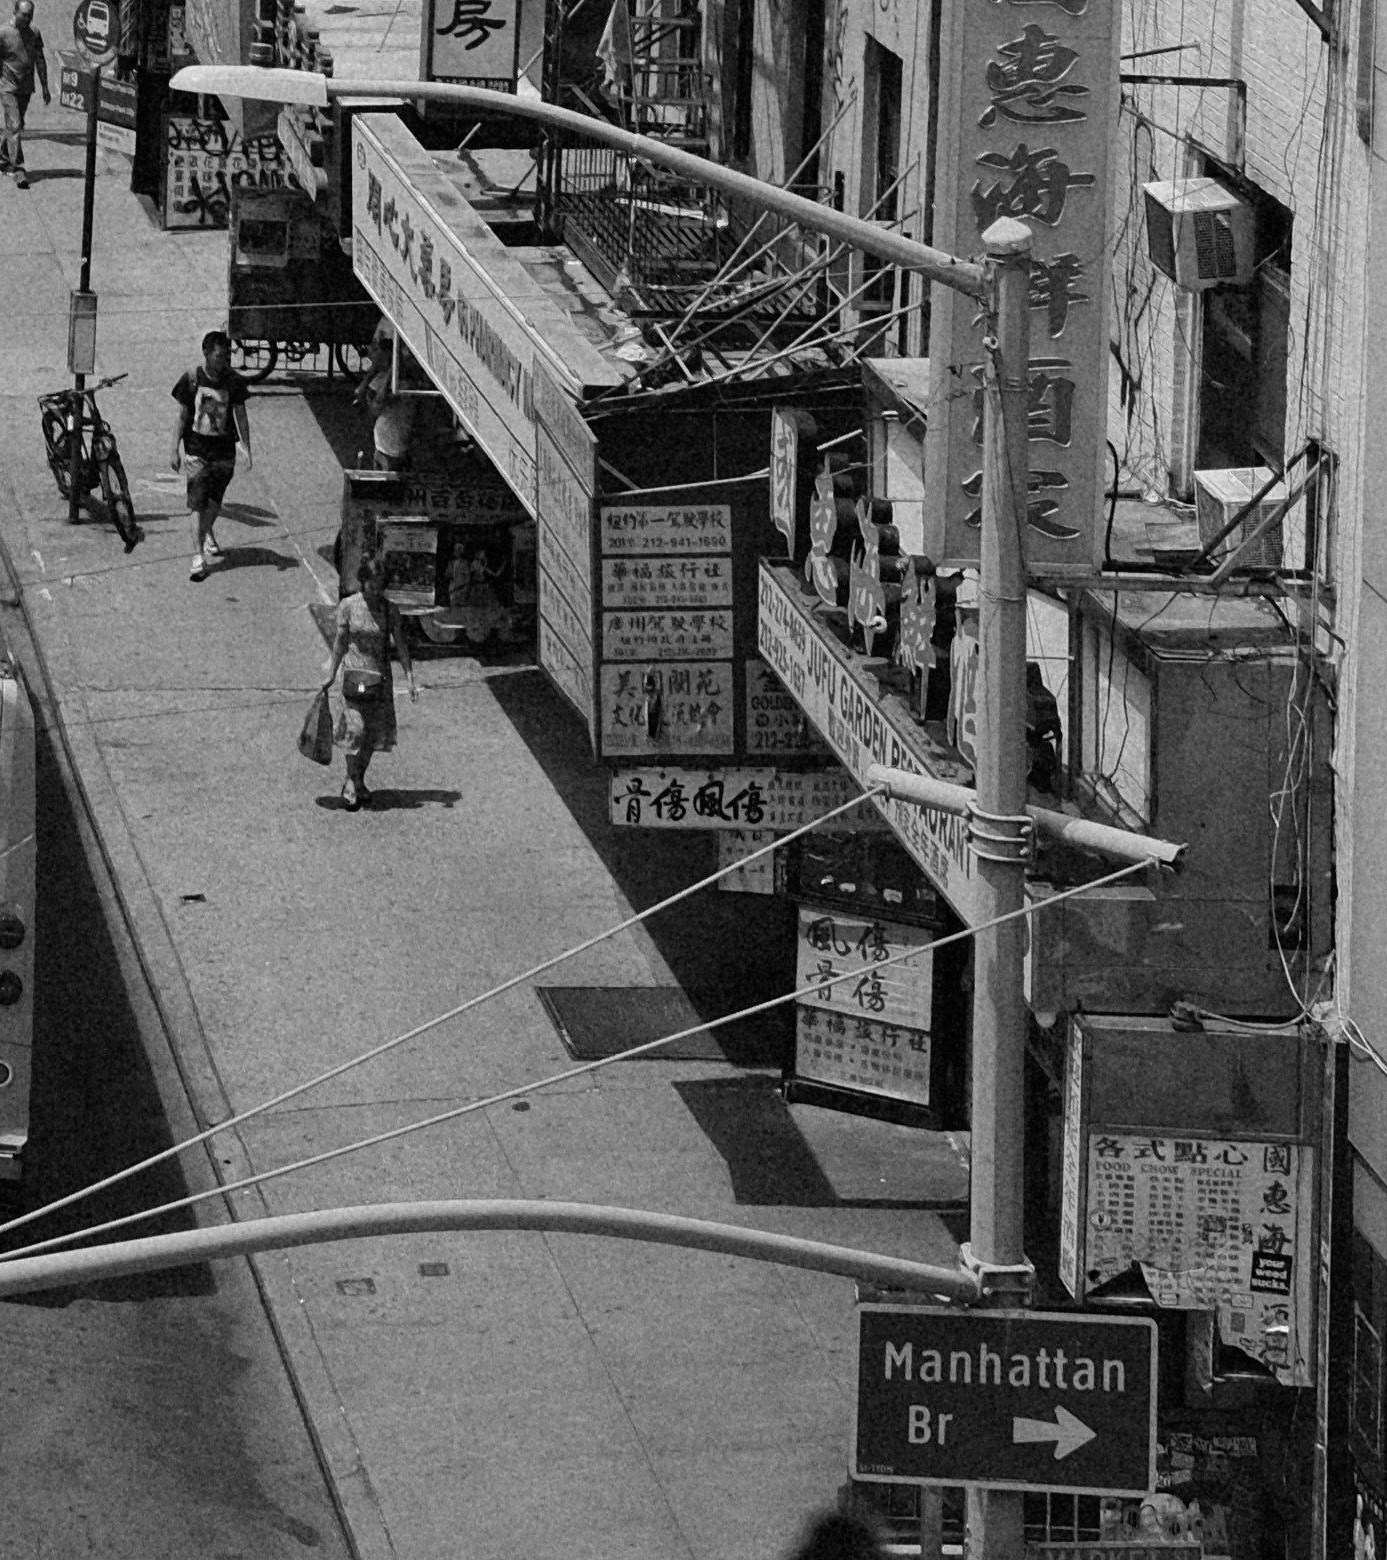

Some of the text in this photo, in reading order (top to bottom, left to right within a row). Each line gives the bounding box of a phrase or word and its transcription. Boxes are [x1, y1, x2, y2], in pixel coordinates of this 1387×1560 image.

[807, 637, 837, 706] JUFU
[840, 674, 889, 767] GARDEN
[1094, 1137, 1249, 1165] 各式點心
[1095, 1160, 1132, 1171] FOOD
[1189, 1166, 1243, 1179] SPECIAL
[1259, 1258, 1286, 1270] your
[884, 1340, 1126, 1393] Manhattan
[908, 1404, 954, 1446] Br
